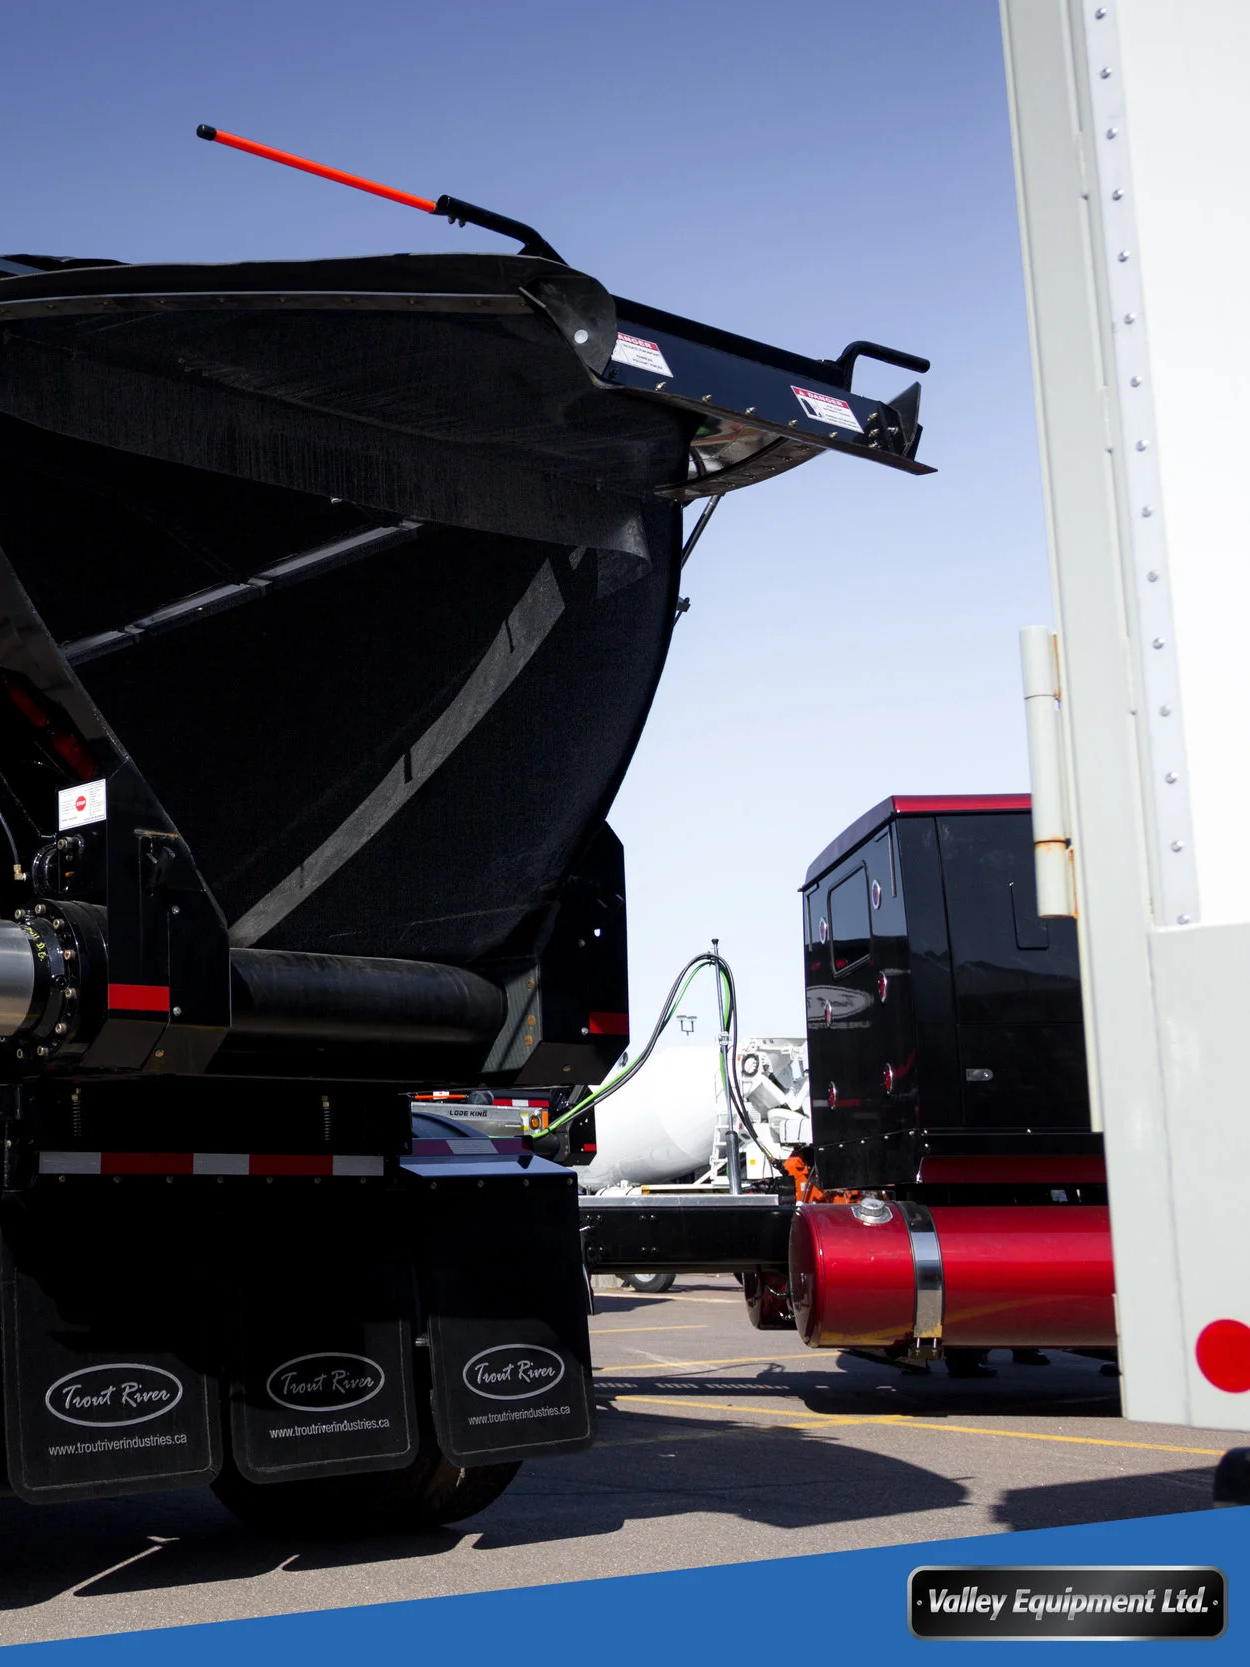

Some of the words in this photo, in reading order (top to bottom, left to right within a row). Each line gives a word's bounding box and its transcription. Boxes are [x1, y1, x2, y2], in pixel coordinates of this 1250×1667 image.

[617, 334, 652, 349] ANGER
[808, 392, 843, 407] DANGER
[281, 1372, 327, 1395] Trout
[332, 1370, 375, 1390] River
[474, 1362, 514, 1385] Trout
[518, 1360, 556, 1381] River
[62, 1384, 114, 1409] Trout
[121, 1382, 170, 1406] River
[468, 1405, 571, 1426] www.troutriverindustries.ca
[269, 1418, 390, 1439] www.troutriverindustries.ca
[48, 1432, 187, 1456] www.troutriverindustries.ca
